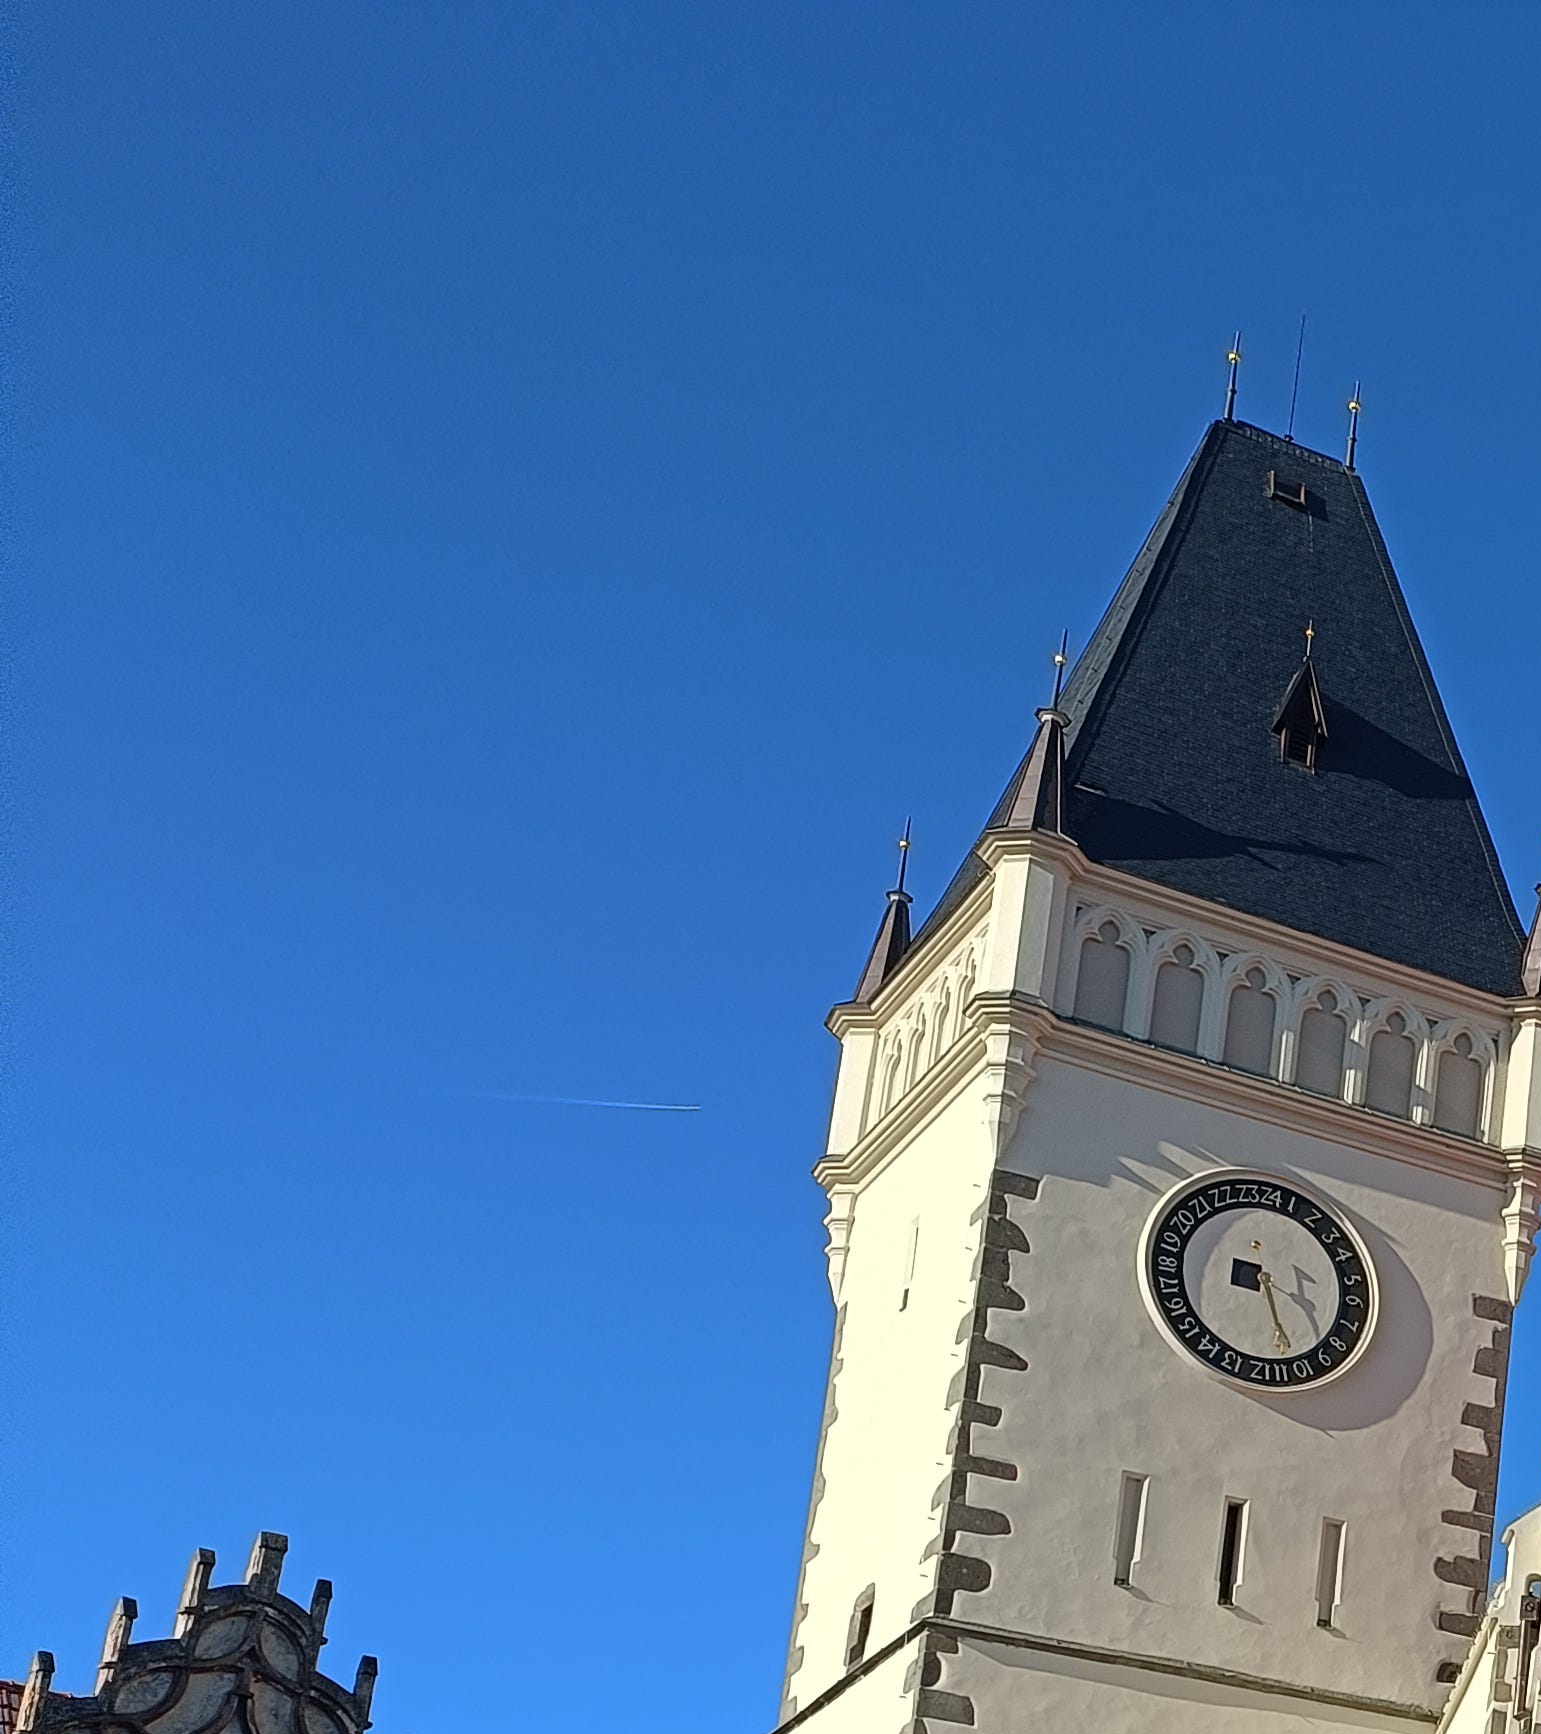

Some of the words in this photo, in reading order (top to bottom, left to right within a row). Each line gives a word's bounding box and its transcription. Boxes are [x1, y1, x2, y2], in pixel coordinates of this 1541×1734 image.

[1287, 1196, 1296, 1214] 1
[1160, 1232, 1182, 1254] 19
[1321, 1227, 1341, 1244] 3
[1335, 1247, 1354, 1263] 4
[1157, 1255, 1178, 1274] 18
[1159, 1274, 1180, 1294] 17
[1343, 1273, 1362, 1287] 5
[1163, 1298, 1187, 1317] 16
[1346, 1295, 1365, 1309] 6
[1339, 1318, 1359, 1334] 7
[1196, 1333, 1221, 1358] 14
[1328, 1336, 1347, 1353] 8
[1220, 1351, 1243, 1374] 13
[1318, 1349, 1333, 1367] 9
[1272, 1363, 1288, 1382] 11
[1293, 1358, 1314, 1379] 10
